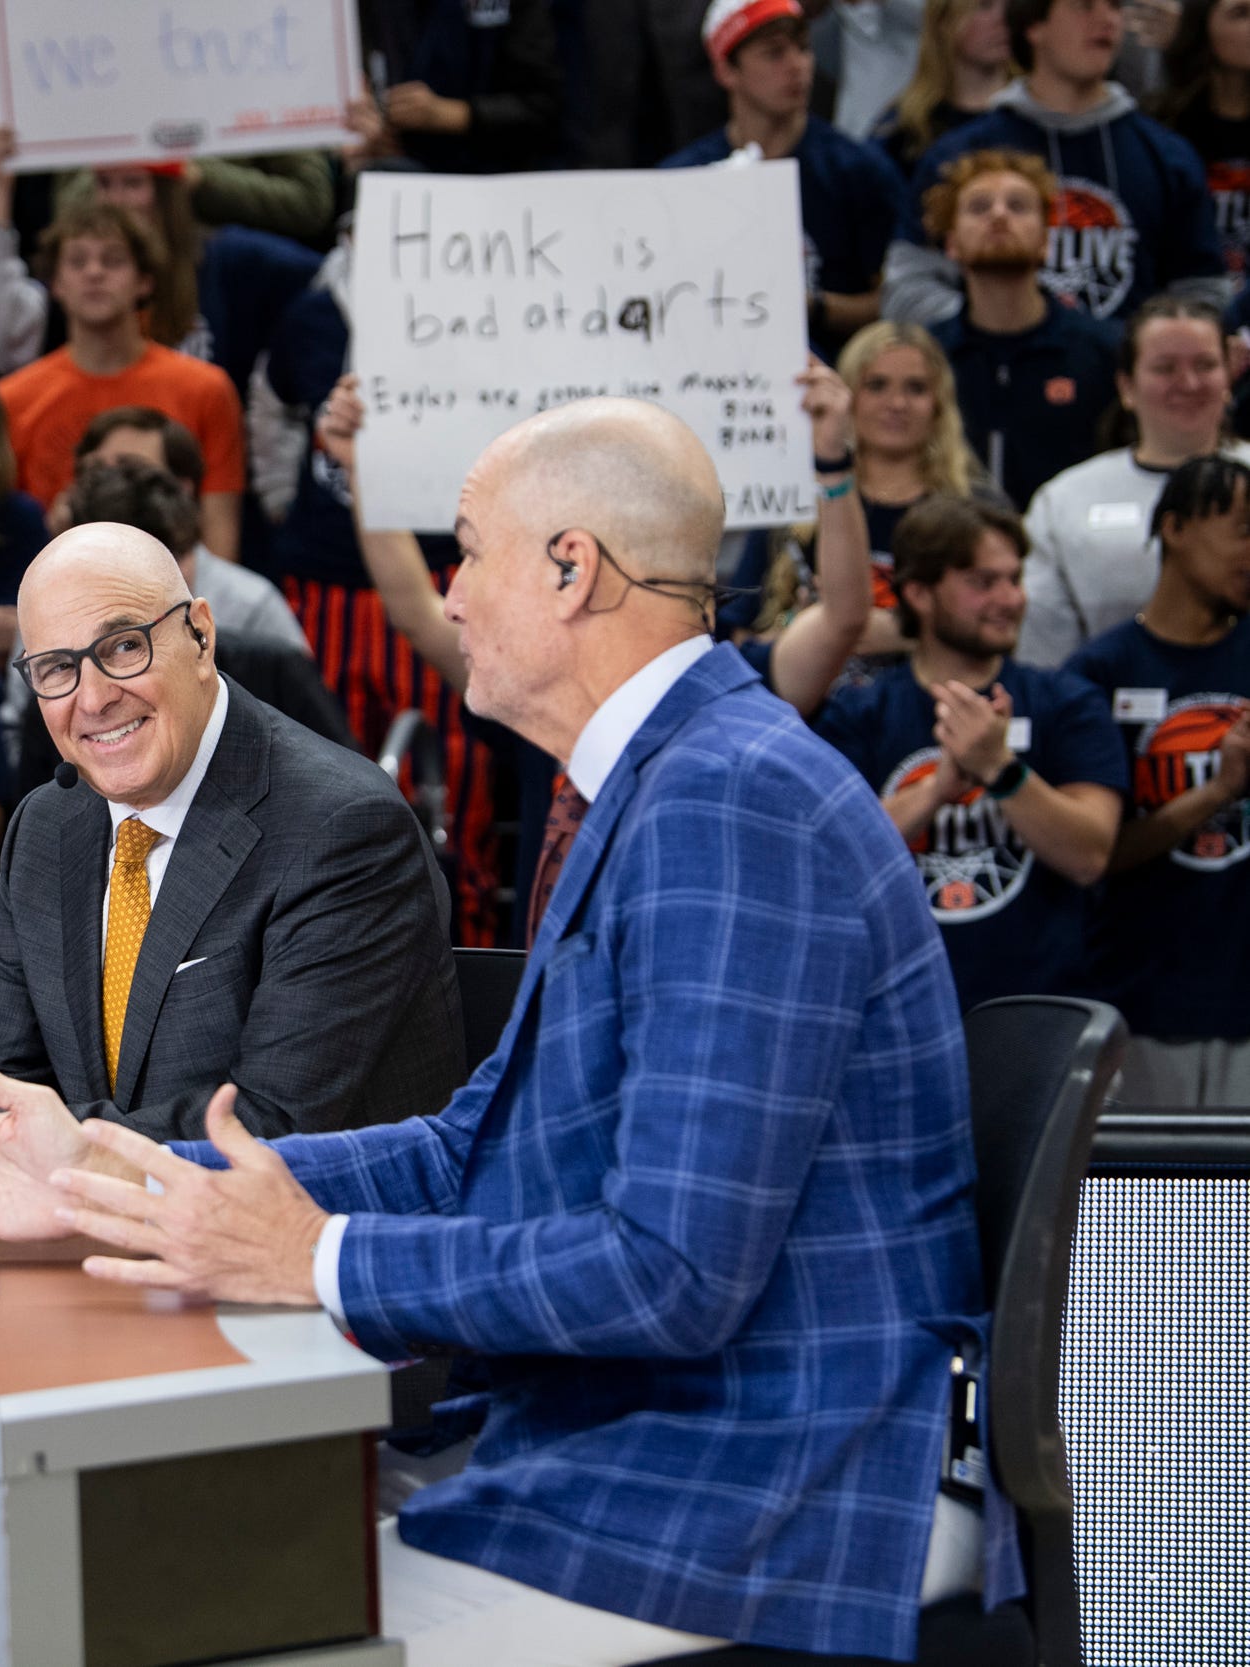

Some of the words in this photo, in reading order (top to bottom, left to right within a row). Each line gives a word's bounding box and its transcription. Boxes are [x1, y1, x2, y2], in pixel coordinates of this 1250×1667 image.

[159, 7, 306, 76] trust
[390, 189, 564, 280] Hank
[612, 227, 655, 272] is
[404, 292, 500, 348] bad
[522, 290, 571, 332] at
[581, 267, 770, 344] darts
